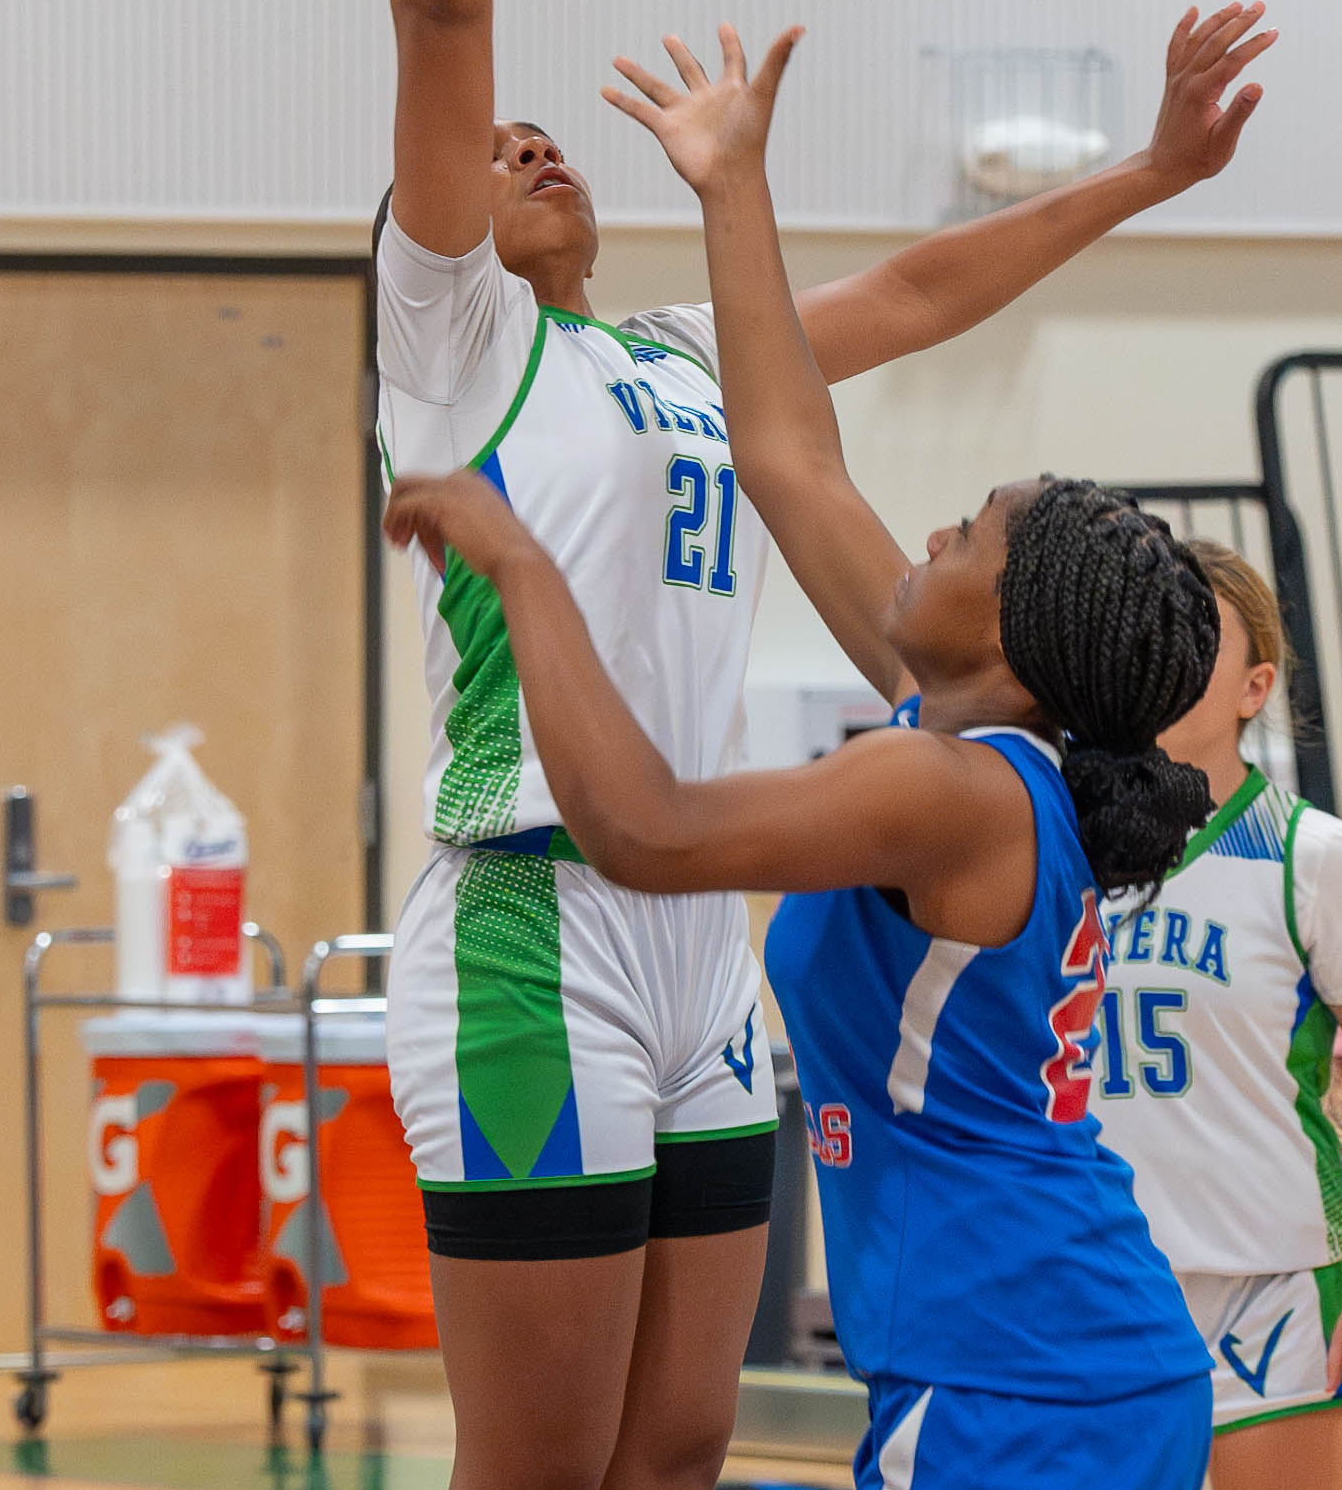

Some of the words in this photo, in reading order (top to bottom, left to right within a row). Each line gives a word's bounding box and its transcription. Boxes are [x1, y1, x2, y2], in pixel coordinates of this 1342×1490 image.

[662, 453, 739, 597] 21
[1099, 986, 1193, 1100] 15
[90, 1094, 139, 1196] G
[260, 1099, 309, 1203] G
